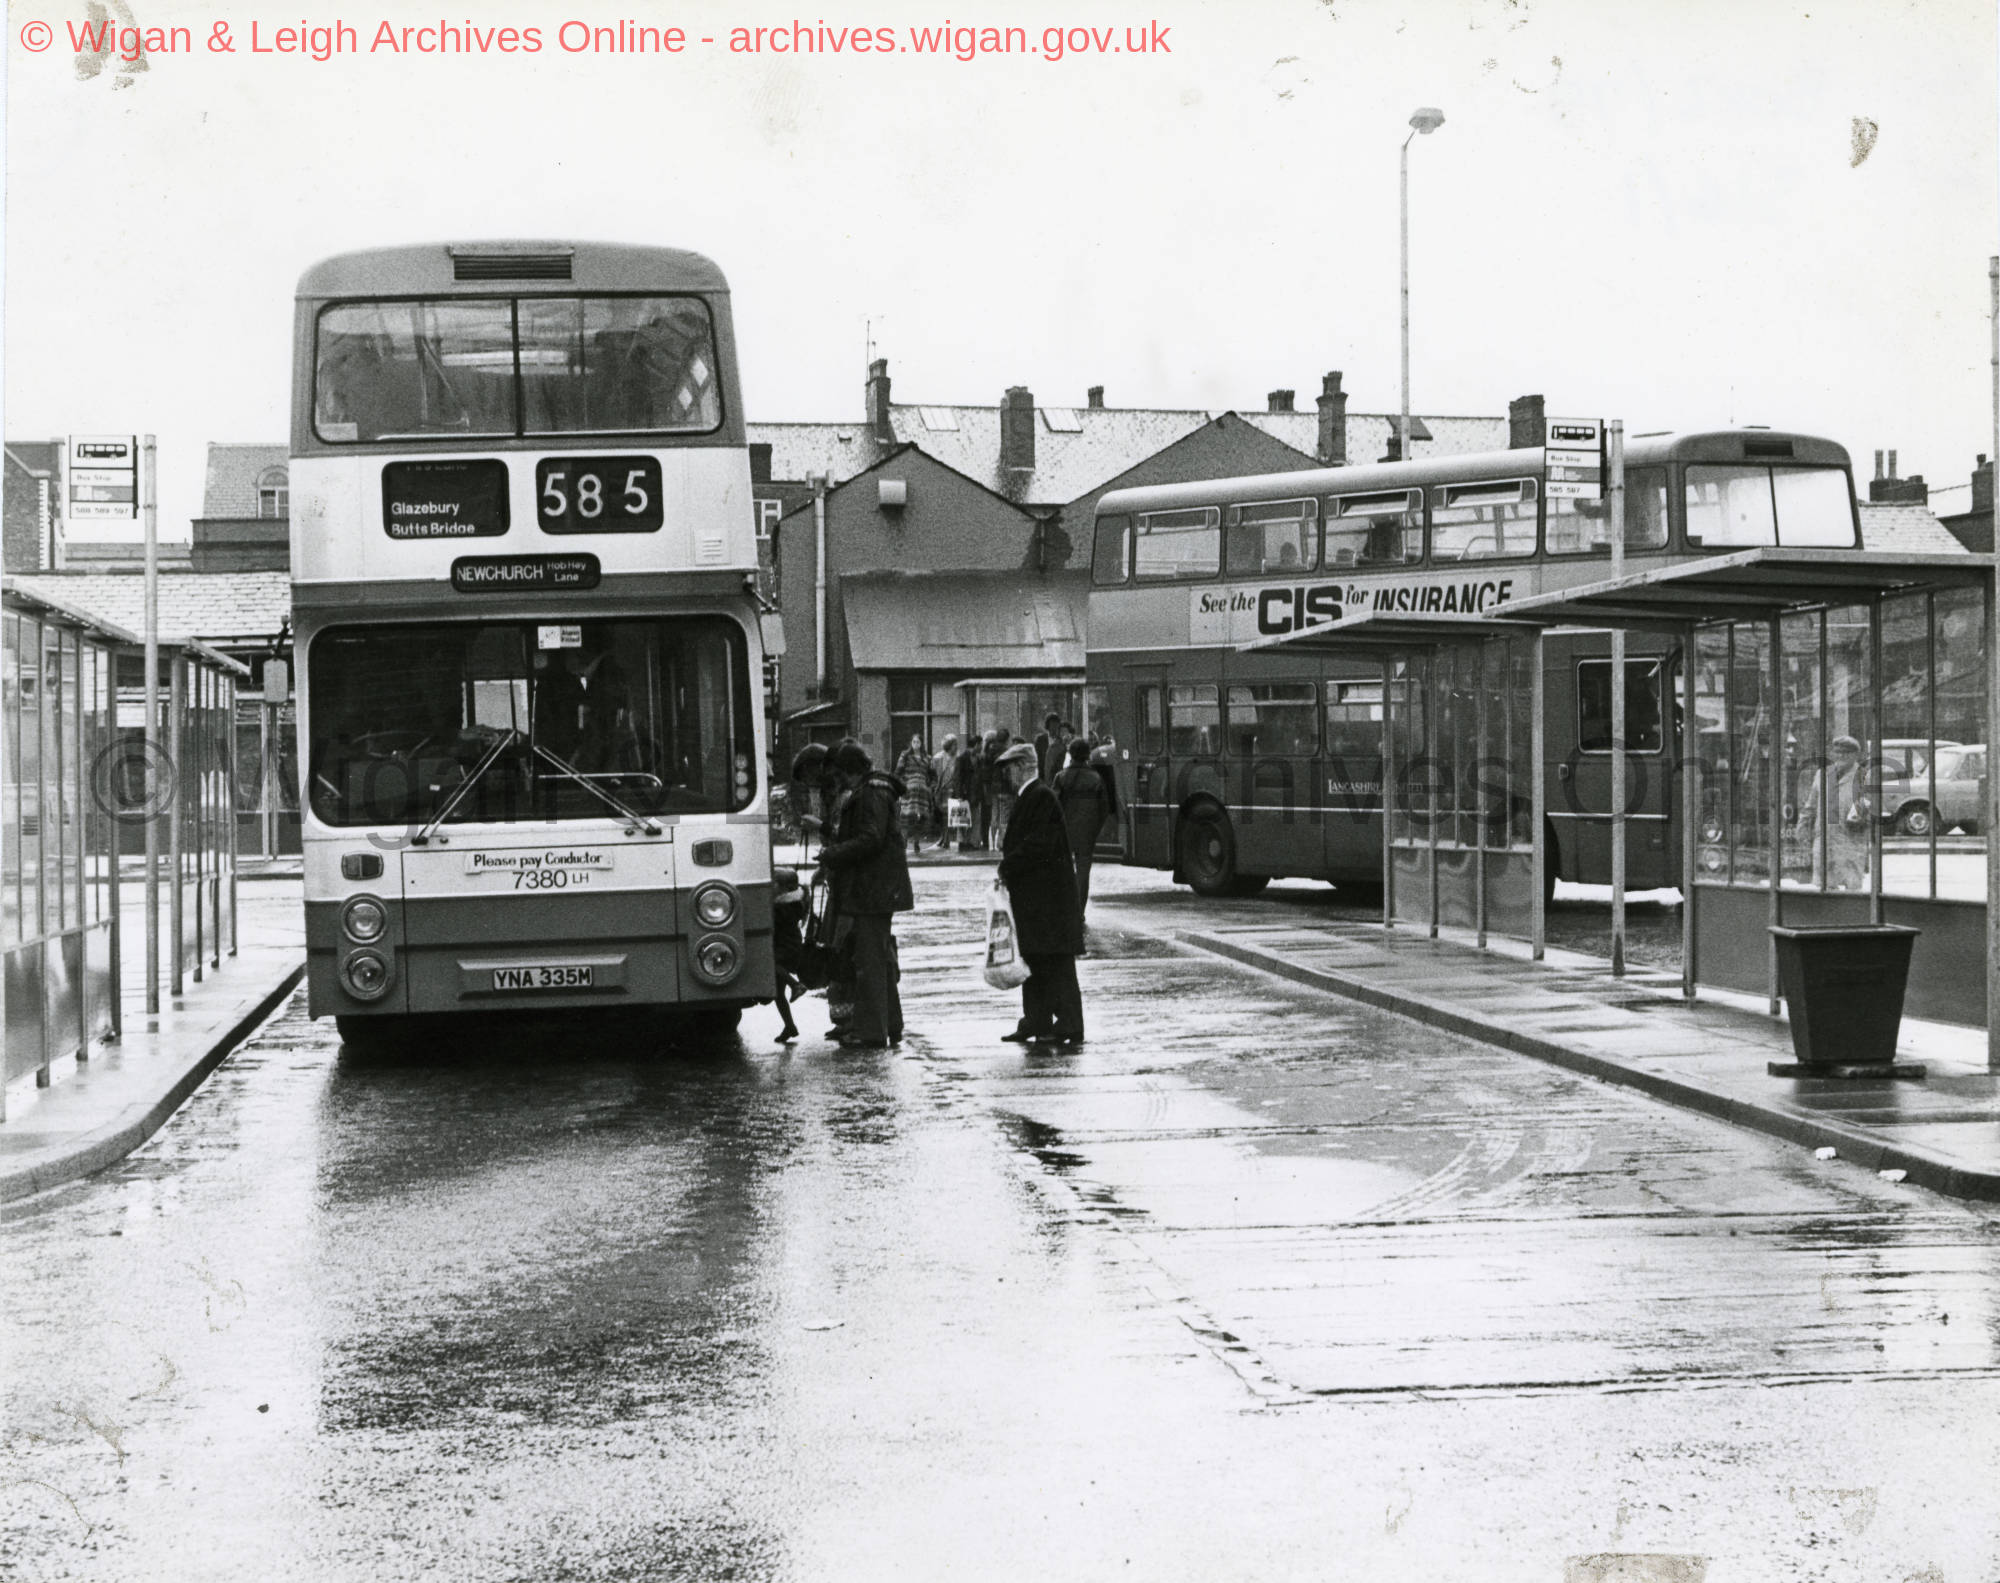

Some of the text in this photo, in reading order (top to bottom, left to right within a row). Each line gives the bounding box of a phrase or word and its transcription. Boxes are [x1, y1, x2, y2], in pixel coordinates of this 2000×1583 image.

[391, 501, 460, 517] Glazebury
[391, 522, 429, 536] Butts
[456, 564, 544, 581] NEWCHURCH
[554, 572, 580, 582] Lane
[1200, 593, 1227, 613] See
[1230, 592, 1256, 612] the
[1258, 585, 1344, 636] CIS
[1345, 584, 1370, 605] for
[474, 851, 602, 868] Please pay Conductor
[512, 869, 589, 889] 7380 LH
[496, 967, 591, 987] YNA 335M
